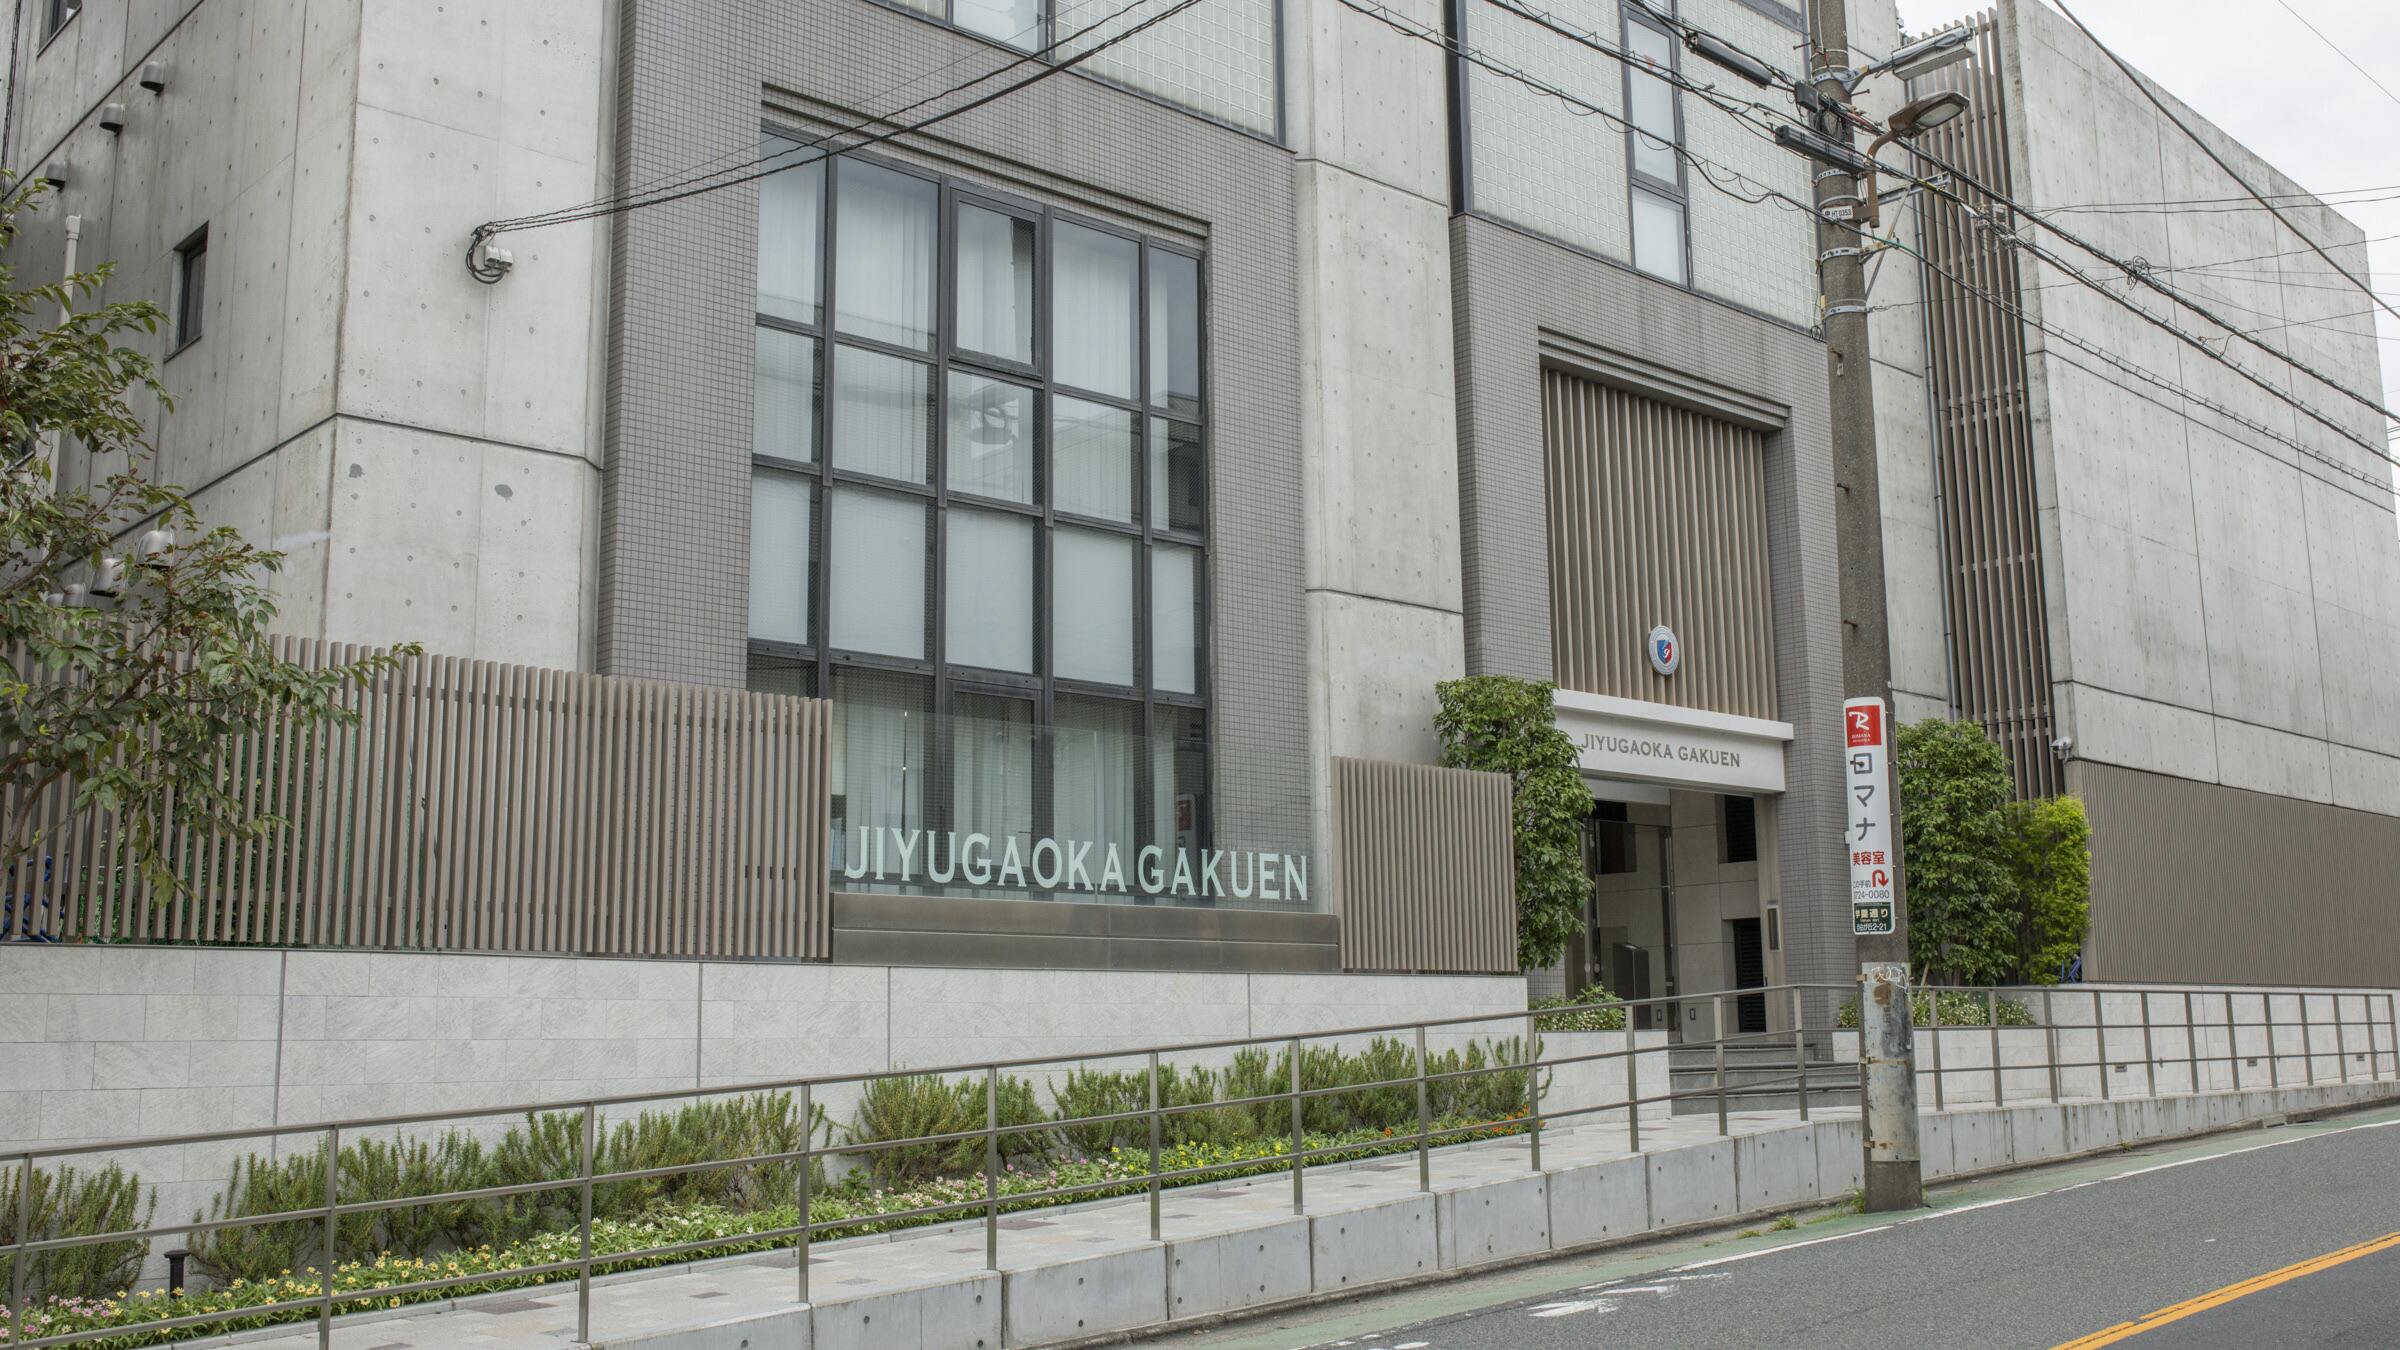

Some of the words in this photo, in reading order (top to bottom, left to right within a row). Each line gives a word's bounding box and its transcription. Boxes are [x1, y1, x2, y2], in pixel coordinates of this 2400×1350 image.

[1581, 733, 1674, 760] JIYUGAOKA
[1678, 746, 1741, 768] GAKUEN
[1853, 752, 1876, 841] ロマナ
[844, 825, 1127, 893] JIYUGAOKA
[1138, 845, 1308, 901] GAKUEN
[1854, 851, 1885, 865] 美容室
